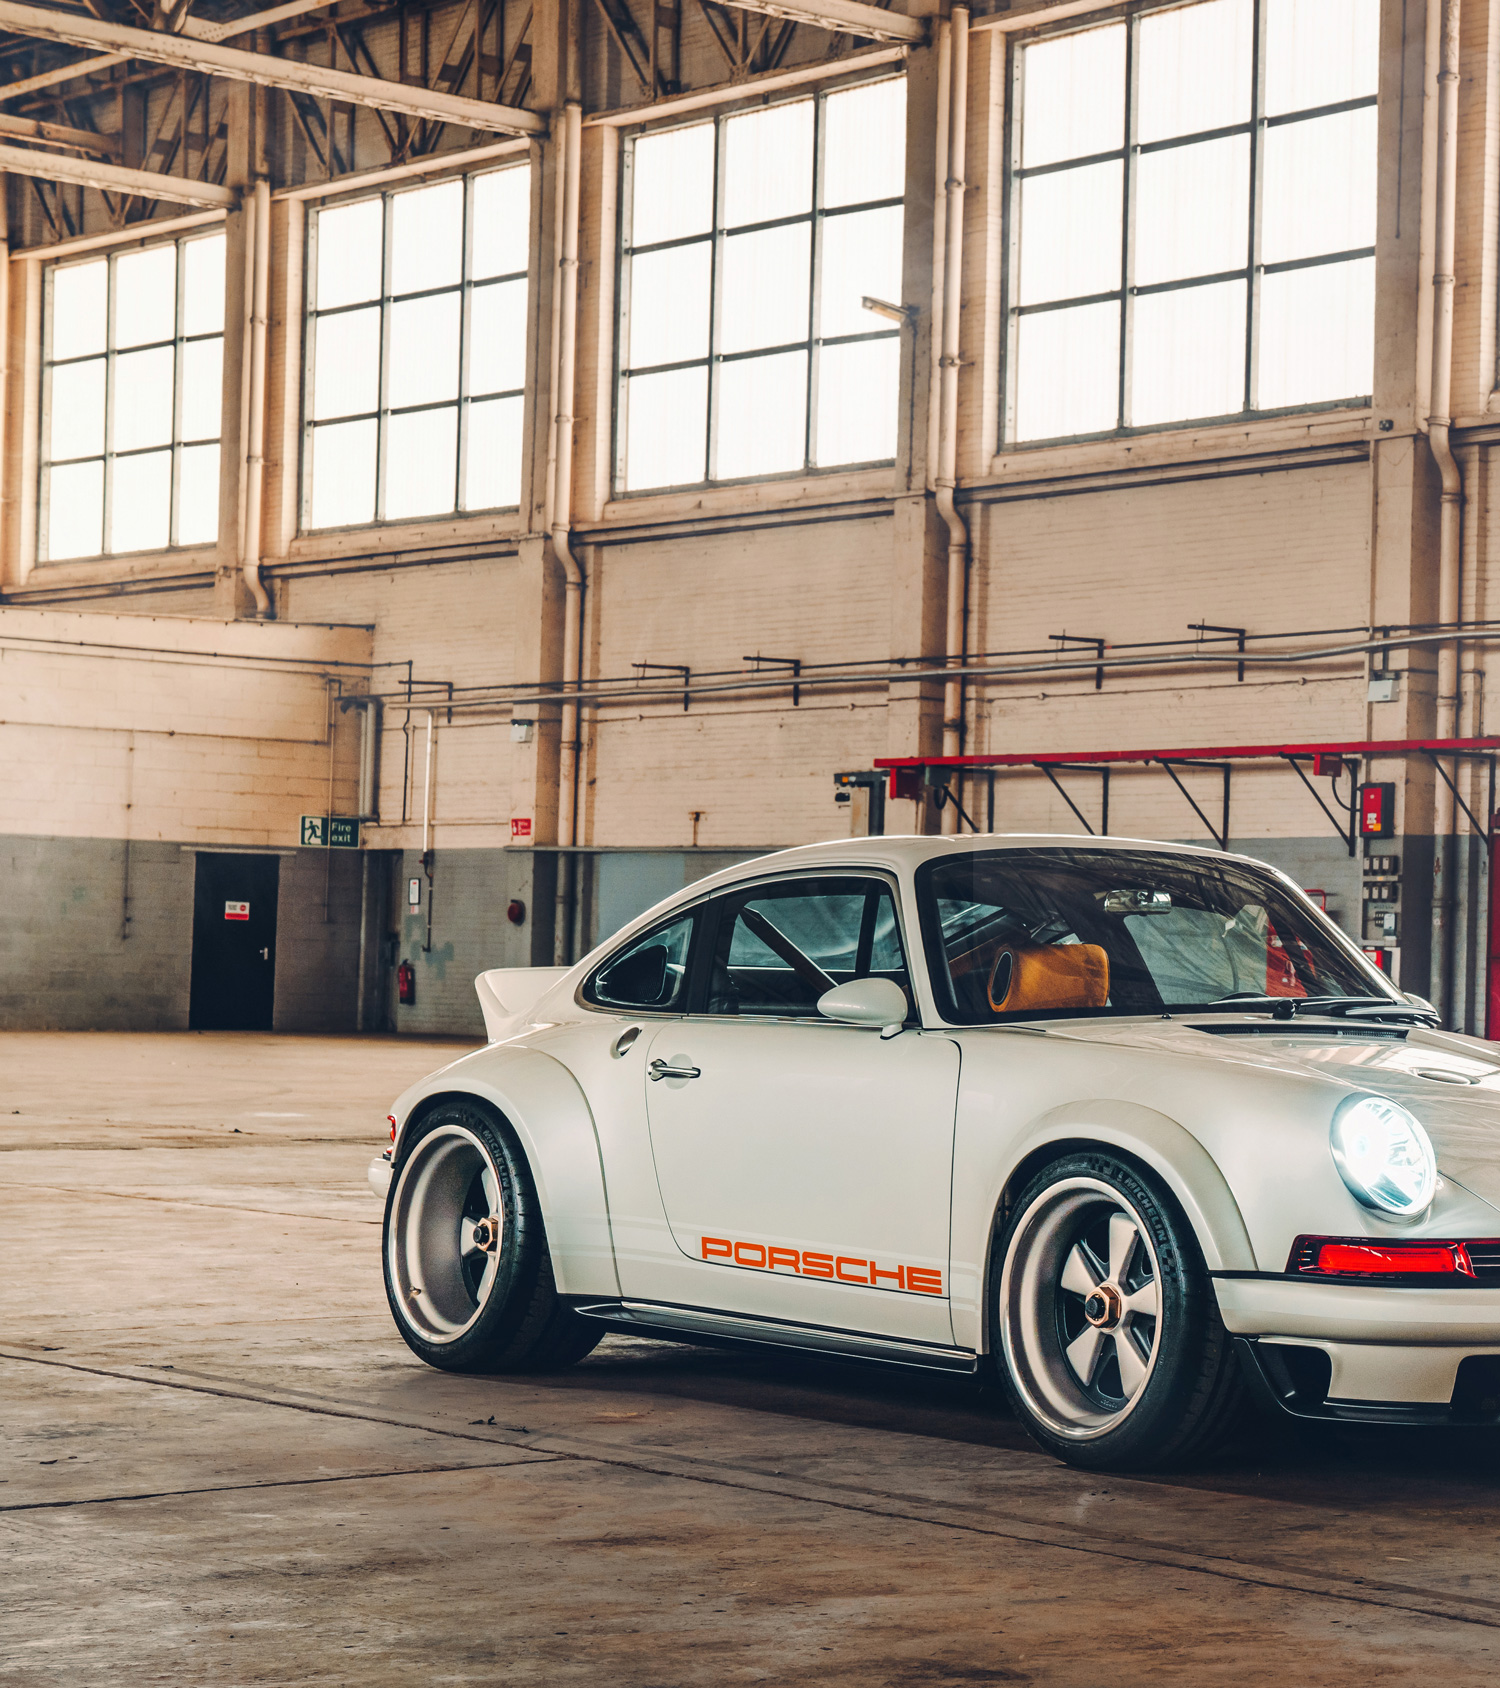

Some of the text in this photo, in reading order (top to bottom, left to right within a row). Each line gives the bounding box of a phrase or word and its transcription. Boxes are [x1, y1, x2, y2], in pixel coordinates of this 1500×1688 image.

[331, 822, 352, 832] Fire
[331, 834, 351, 842] exit
[482, 1129, 510, 1188] MICHELIN
[1125, 1177, 1167, 1242] MICHELIN
[701, 1236, 943, 1295] PORSCHE
